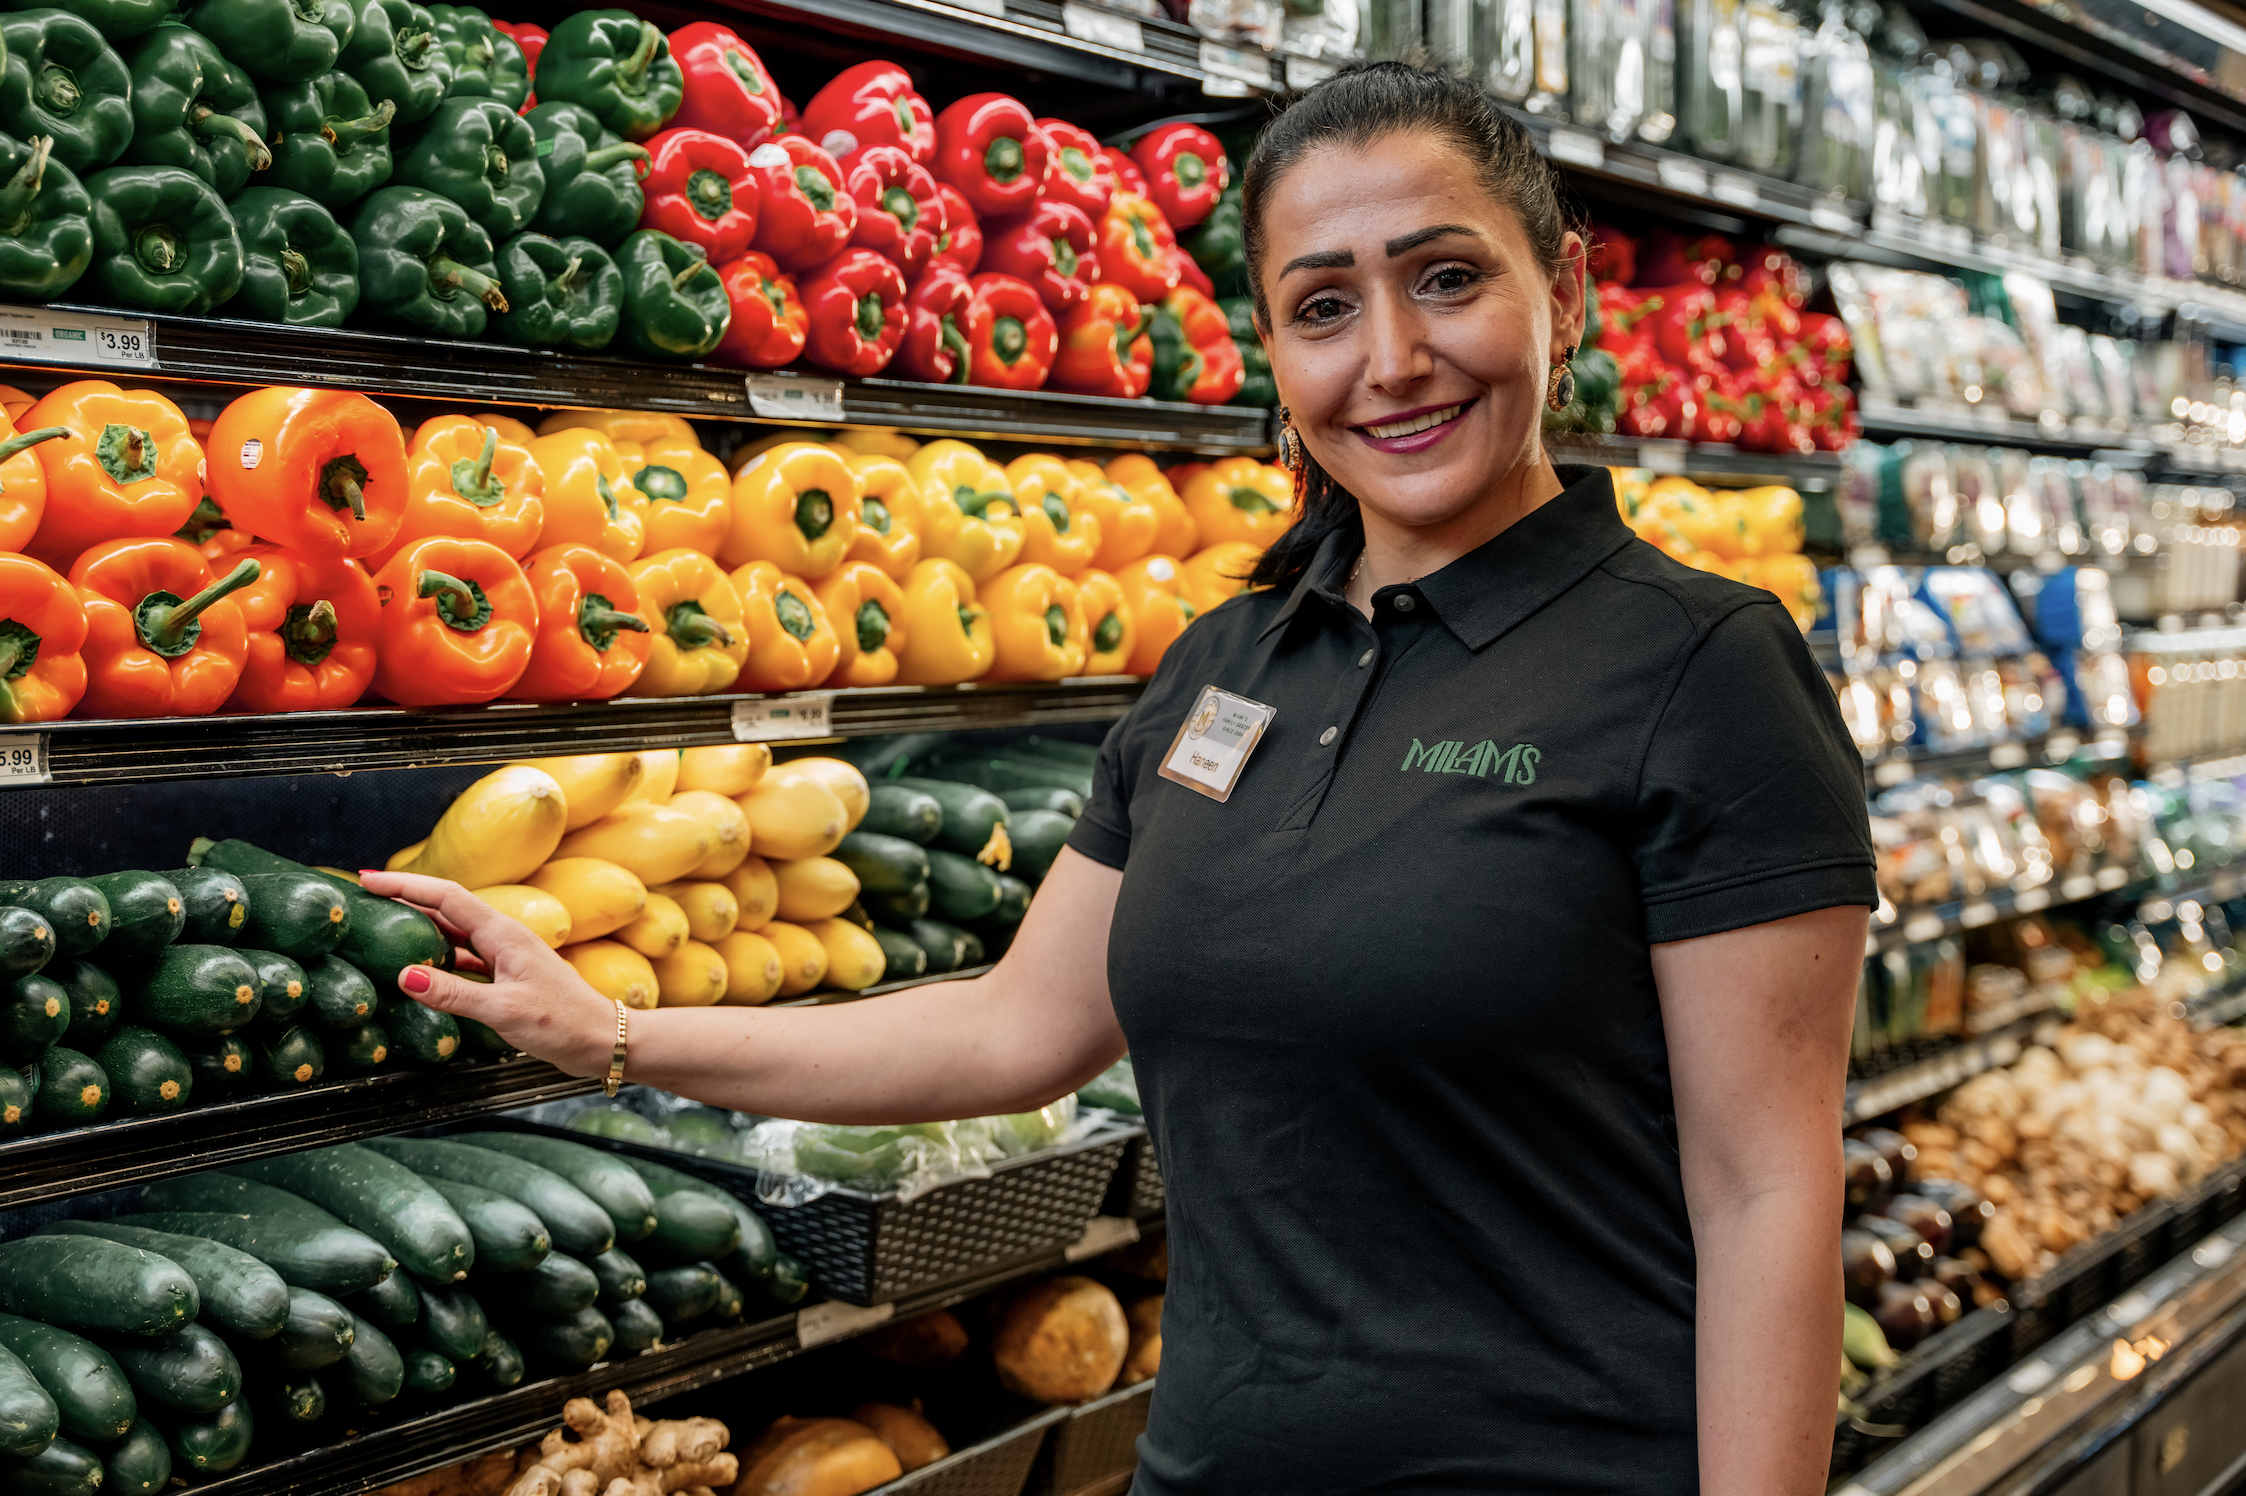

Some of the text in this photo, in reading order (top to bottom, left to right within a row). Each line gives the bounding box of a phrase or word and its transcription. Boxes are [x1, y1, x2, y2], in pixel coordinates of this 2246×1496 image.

[55, 331, 84, 340] ORGANIC
[100, 332, 140, 350] $3.99
[121, 351, 145, 359] Per LB
[1222, 717, 1236, 726] FAMILY
[1222, 726, 1234, 734] SINCE
[0, 749, 32, 766] 5.99
[1189, 750, 1219, 773] Haneen
